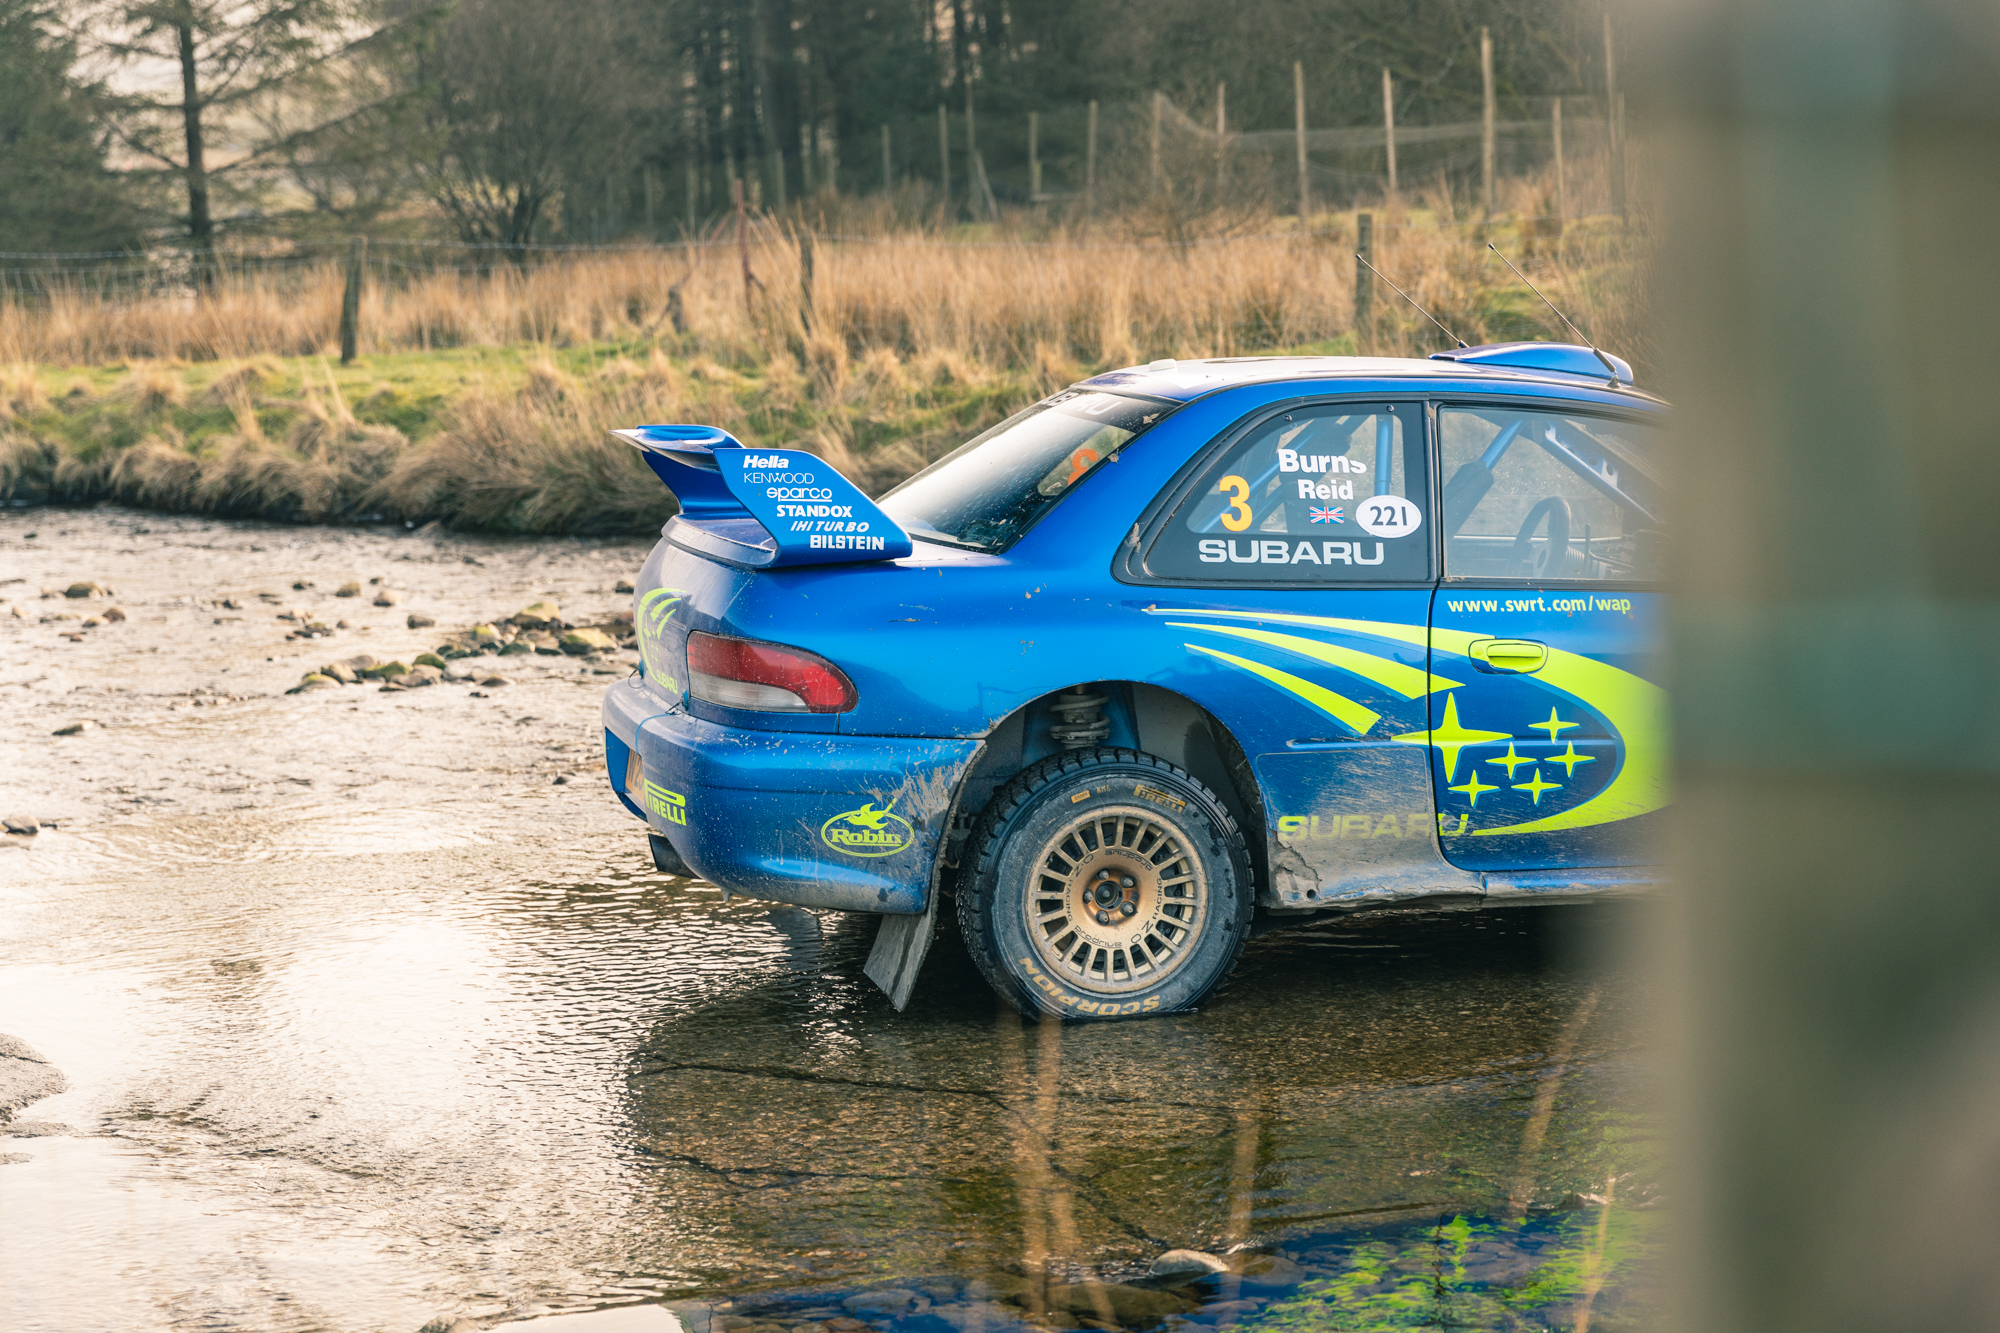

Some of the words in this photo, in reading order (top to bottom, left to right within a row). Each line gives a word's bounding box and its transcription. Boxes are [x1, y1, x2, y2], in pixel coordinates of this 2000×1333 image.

[743, 455, 789, 469] Hella
[1277, 448, 1367, 474] Burns
[744, 472, 815, 484] KENWOOD
[766, 487, 833, 502] sparco
[1297, 479, 1354, 500] Reid
[777, 505, 852, 518] STANDOX
[1218, 475, 1253, 532] 3
[790, 520, 814, 532] IHI
[815, 520, 870, 533] TURBO
[1370, 505, 1408, 527] 221
[809, 535, 885, 550] BILSTEIN
[1198, 539, 1385, 566] SUBARU
[1446, 595, 1631, 614] www.swrt.com/wap
[656, 669, 679, 694] SUBARU
[644, 778, 687, 827] PIRELLI
[1278, 813, 1469, 841] SUBARU
[830, 829, 903, 847] Robin
[1018, 957, 1161, 1016] SCORPION
